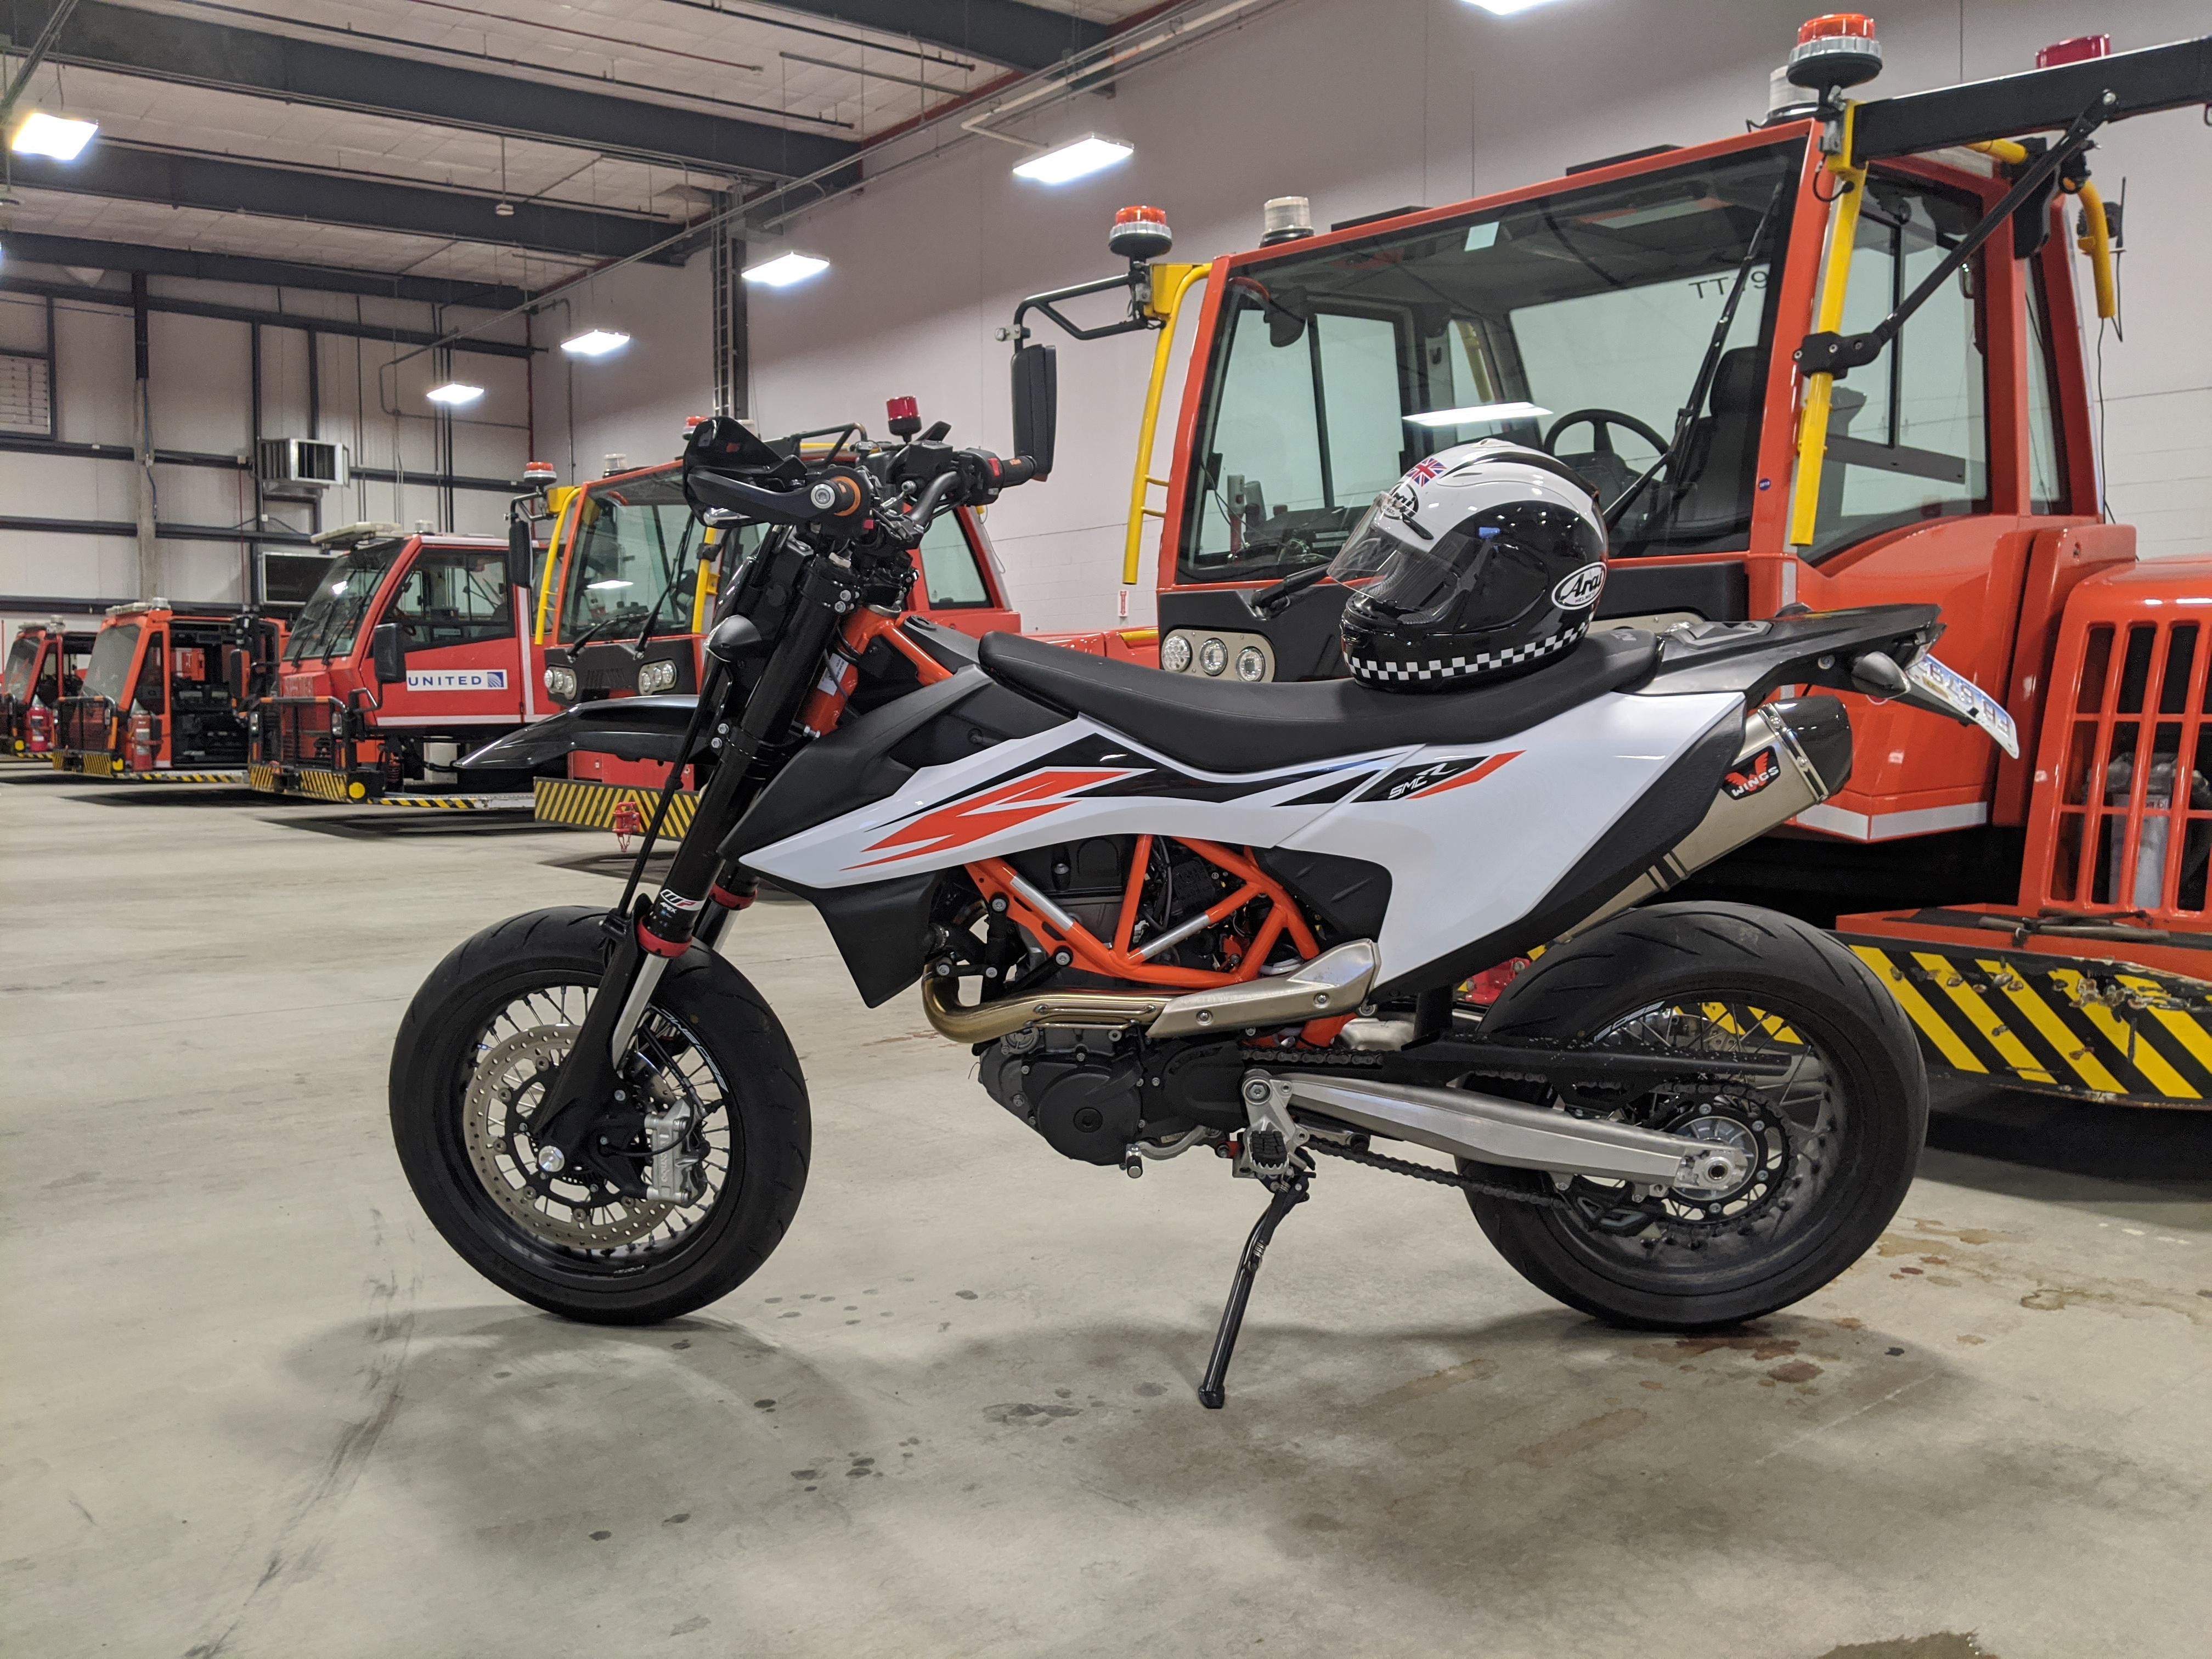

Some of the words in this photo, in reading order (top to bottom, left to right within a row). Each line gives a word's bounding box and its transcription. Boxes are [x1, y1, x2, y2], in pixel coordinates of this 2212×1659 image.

[1688, 270, 1767, 299] TT9
[408, 675, 482, 686] UNITED
[1387, 775, 1428, 800] SMC
[1731, 766, 1779, 797] WINGS
[659, 902, 678, 914] APEX
[659, 1139, 669, 1183] bembo
